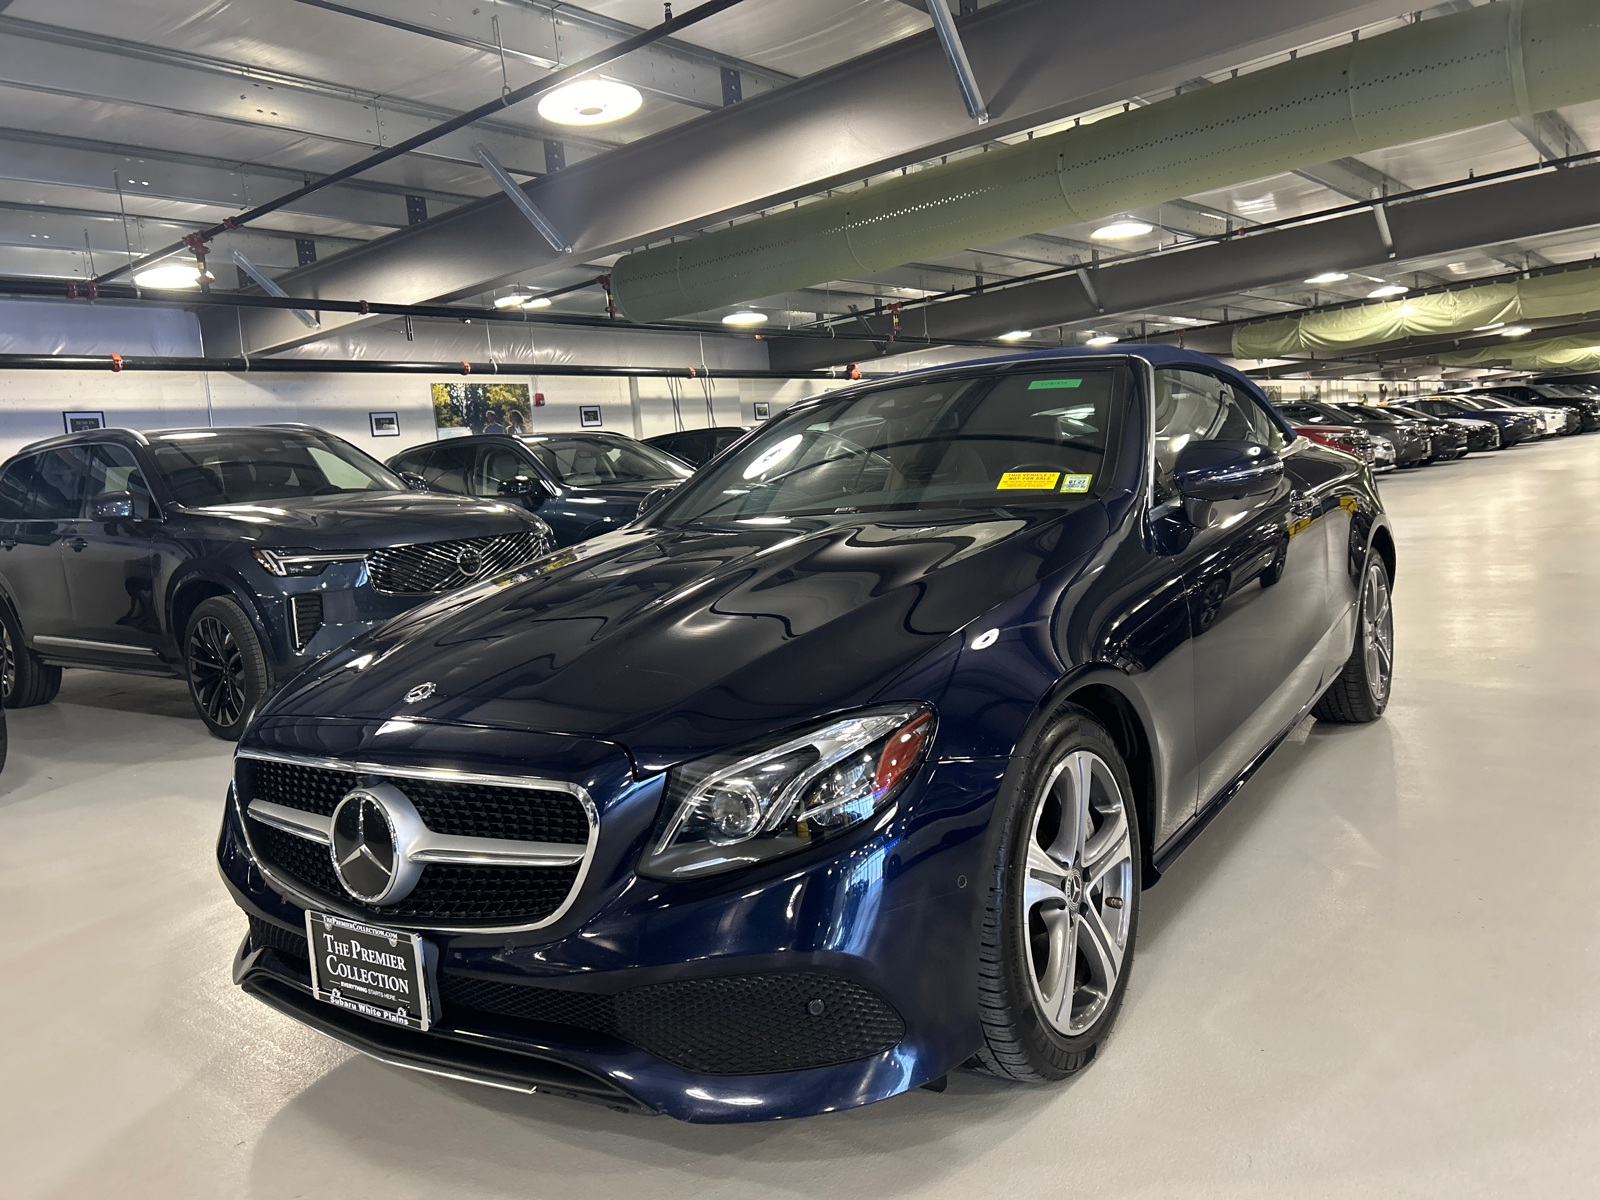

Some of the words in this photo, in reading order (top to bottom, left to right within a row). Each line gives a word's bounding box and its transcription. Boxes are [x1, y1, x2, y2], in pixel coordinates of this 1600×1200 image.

[322, 933, 350, 957] THE
[350, 939, 407, 971] PREMIER
[326, 954, 409, 994] COLLECTION
[340, 981, 367, 993] EVERYTHING
[368, 988, 384, 998] STARTS
[329, 996, 356, 1010] Subaru
[359, 1003, 382, 1017] White
[383, 1011, 409, 1025] Plains
